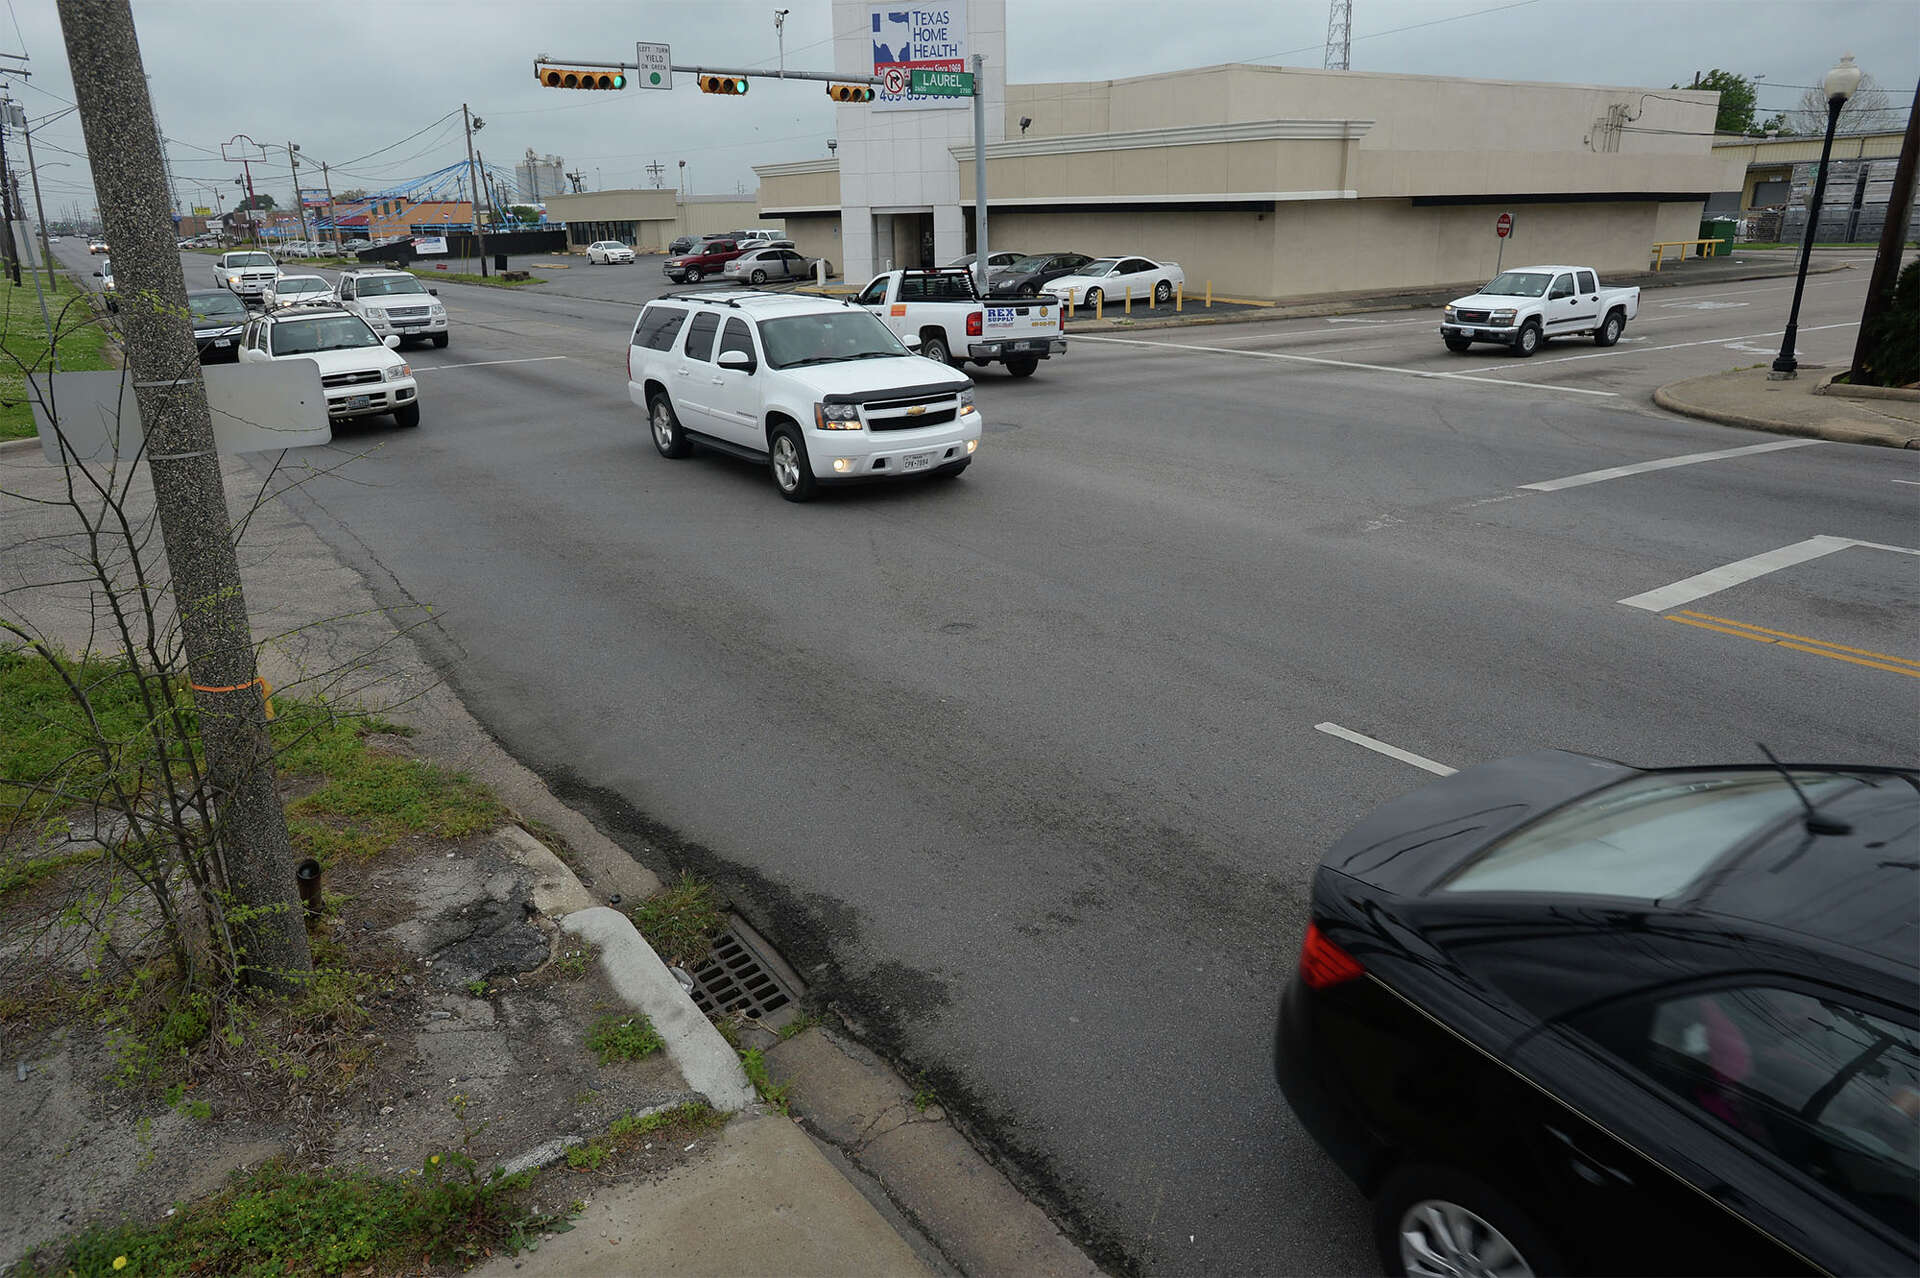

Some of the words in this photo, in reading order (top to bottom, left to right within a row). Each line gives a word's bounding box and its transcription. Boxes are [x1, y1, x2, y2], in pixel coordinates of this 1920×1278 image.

[912, 11, 950, 26] TEXAS
[913, 27, 948, 42] HOME
[914, 43, 958, 58] HEALTH
[645, 54, 664, 63] YIELD
[923, 73, 962, 87] LAUREL
[987, 308, 1014, 317] REX
